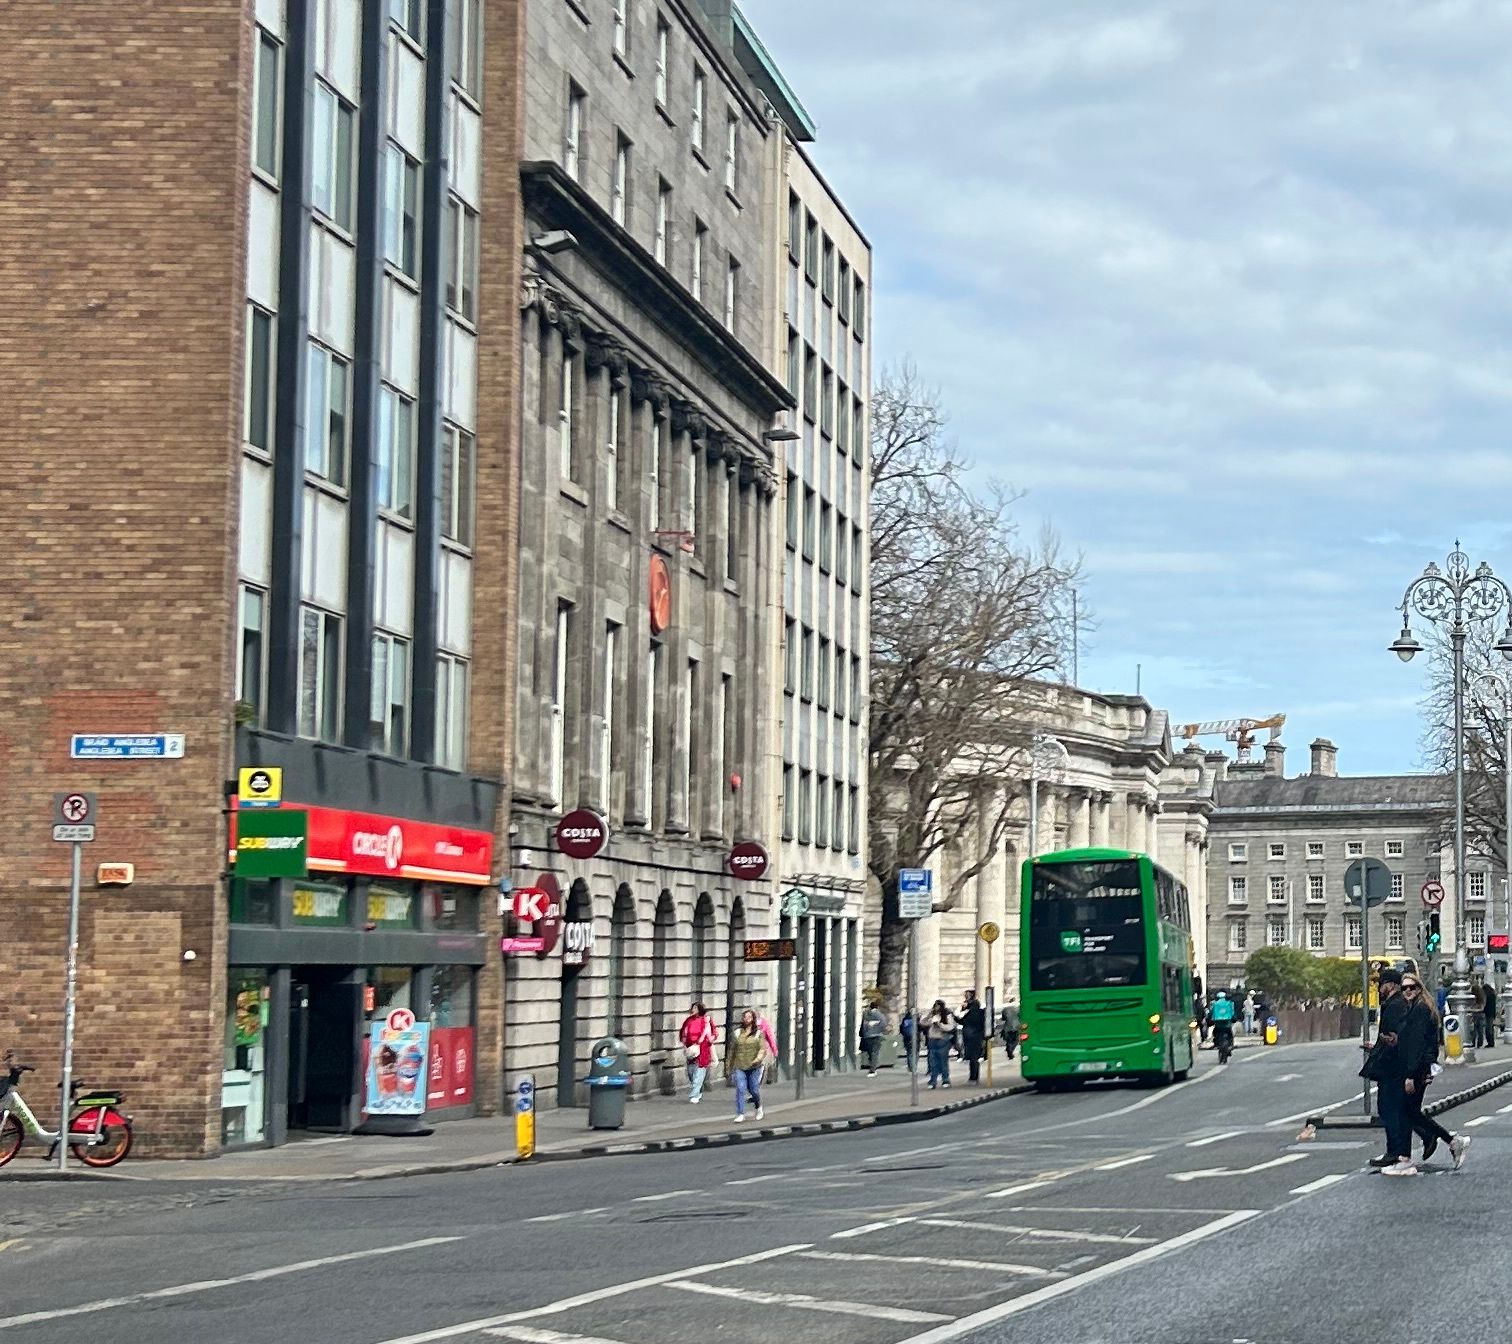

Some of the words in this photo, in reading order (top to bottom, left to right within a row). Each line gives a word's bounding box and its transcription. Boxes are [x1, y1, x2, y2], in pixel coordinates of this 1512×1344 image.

[171, 741, 179, 752] 2
[561, 828, 601, 838] COSTA
[237, 837, 304, 849] SUBWAY
[732, 855, 764, 864] COSTA
[517, 894, 544, 920] K
